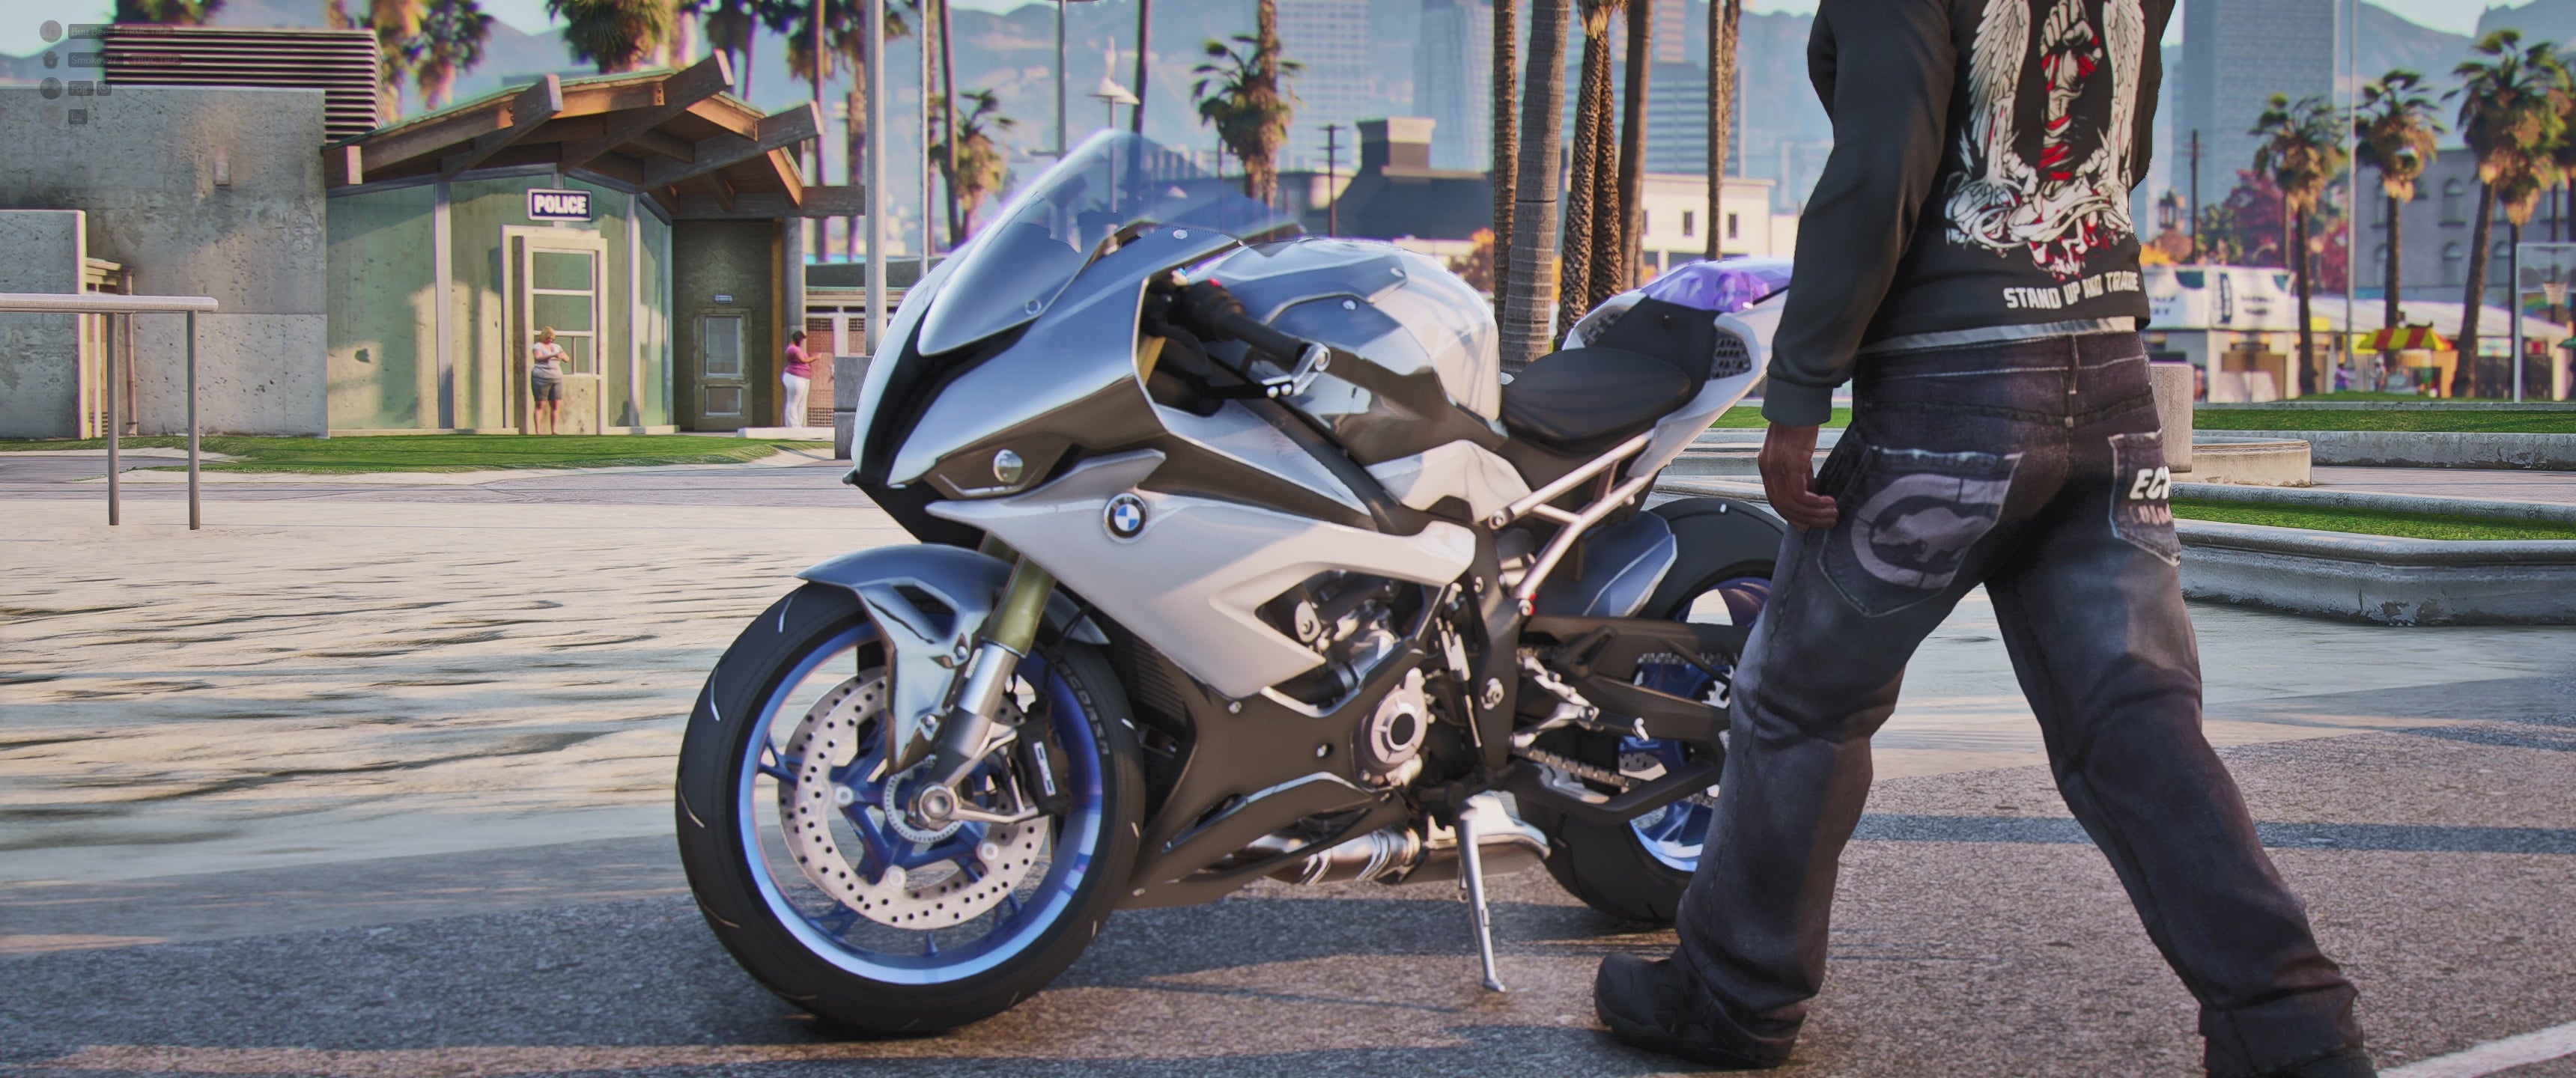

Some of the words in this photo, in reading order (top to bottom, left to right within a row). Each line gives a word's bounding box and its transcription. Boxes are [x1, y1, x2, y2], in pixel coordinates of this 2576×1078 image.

[533, 194, 587, 214] POLICE
[2003, 287, 2062, 309] STAND
[2063, 281, 2081, 305] UP
[2082, 274, 2103, 299] AND
[2105, 270, 2139, 293] TRADE
